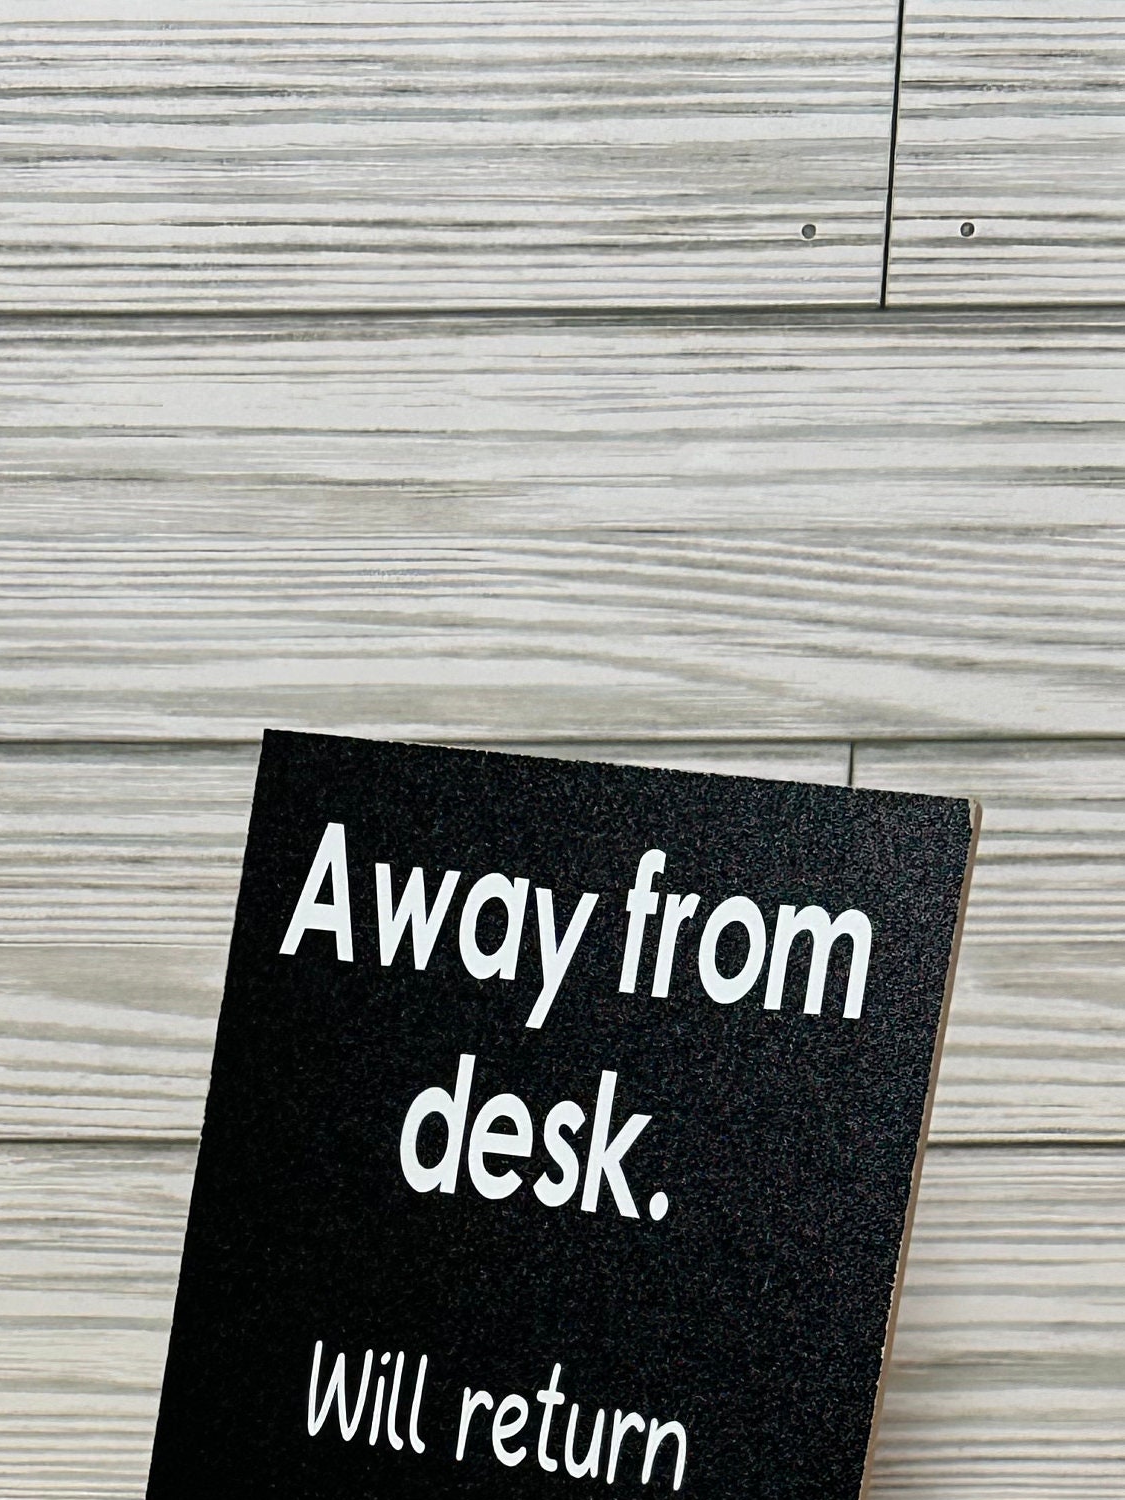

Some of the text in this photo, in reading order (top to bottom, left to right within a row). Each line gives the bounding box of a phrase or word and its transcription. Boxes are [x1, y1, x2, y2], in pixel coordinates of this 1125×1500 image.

[278, 821, 873, 1030] Away from
[399, 1053, 669, 1221] desk.
[307, 1340, 687, 1491] Will return
